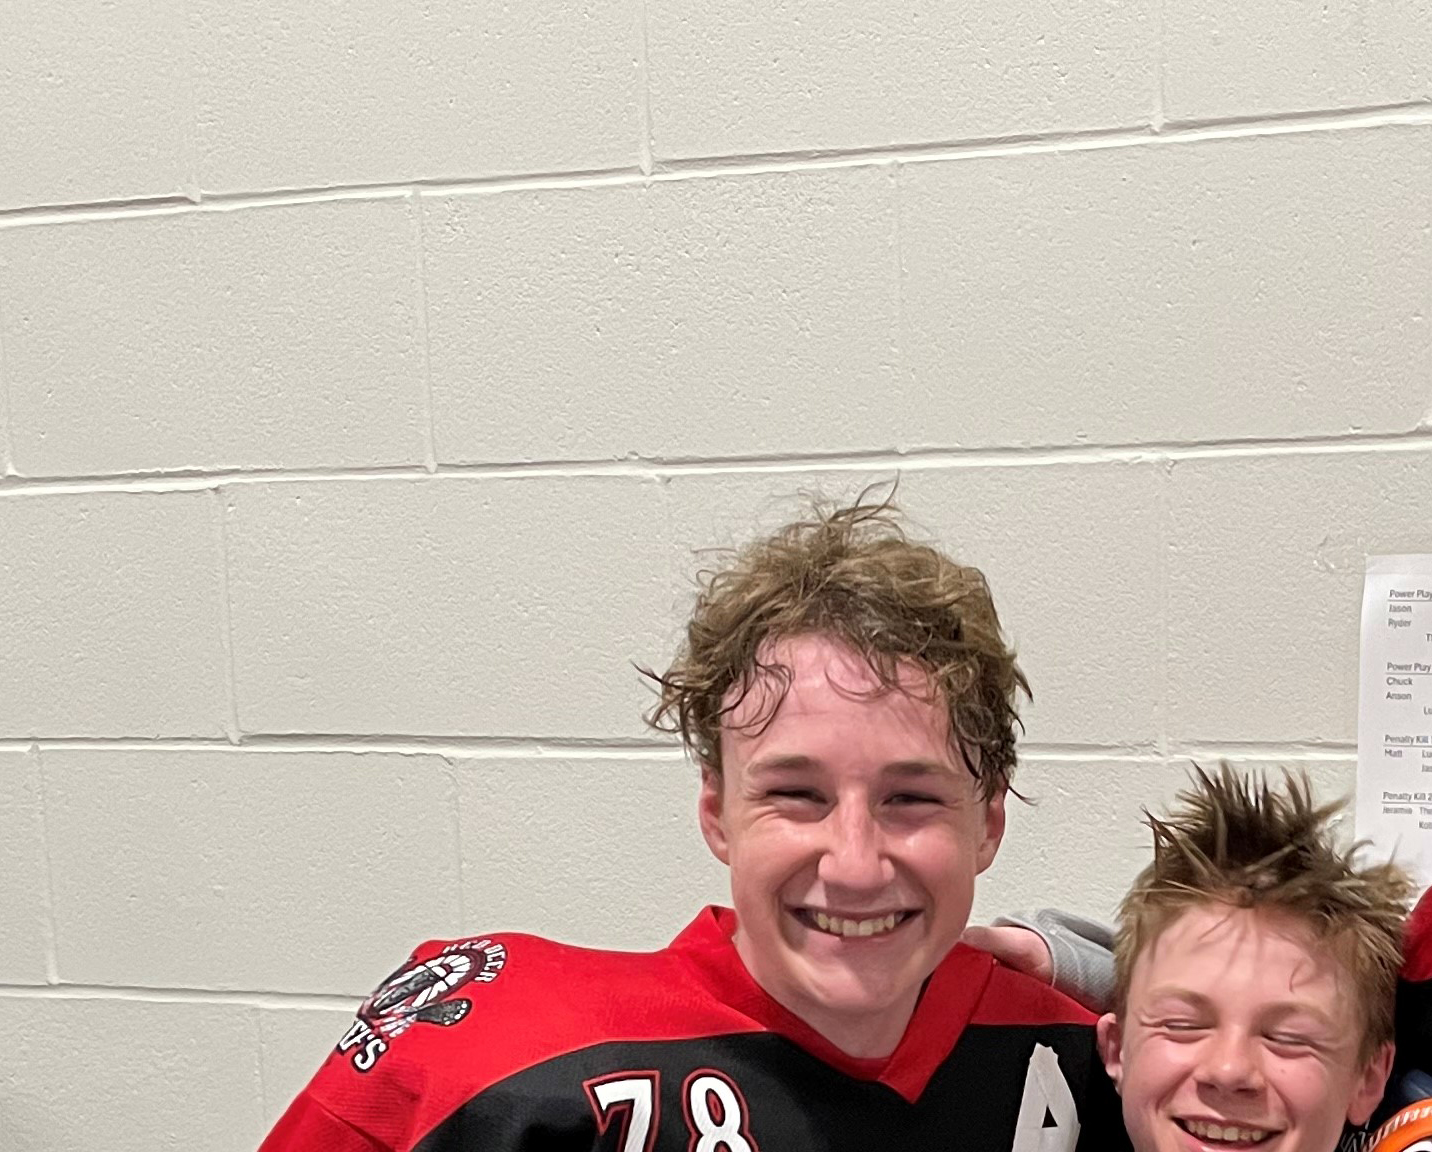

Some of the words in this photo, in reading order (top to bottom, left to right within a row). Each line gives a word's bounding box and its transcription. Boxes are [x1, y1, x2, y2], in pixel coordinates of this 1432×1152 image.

[1389, 589, 1415, 599] Power
[1386, 662, 1412, 671] Power
[1413, 662, 1431, 673] Play
[1386, 676, 1413, 686] Chuck
[1384, 734, 1414, 745] Penalty
[1416, 735, 1429, 744] Kill
[1383, 791, 1413, 802] Penalty
[1413, 793, 1426, 802] Kill
[1427, 793, 1432, 802] 2
